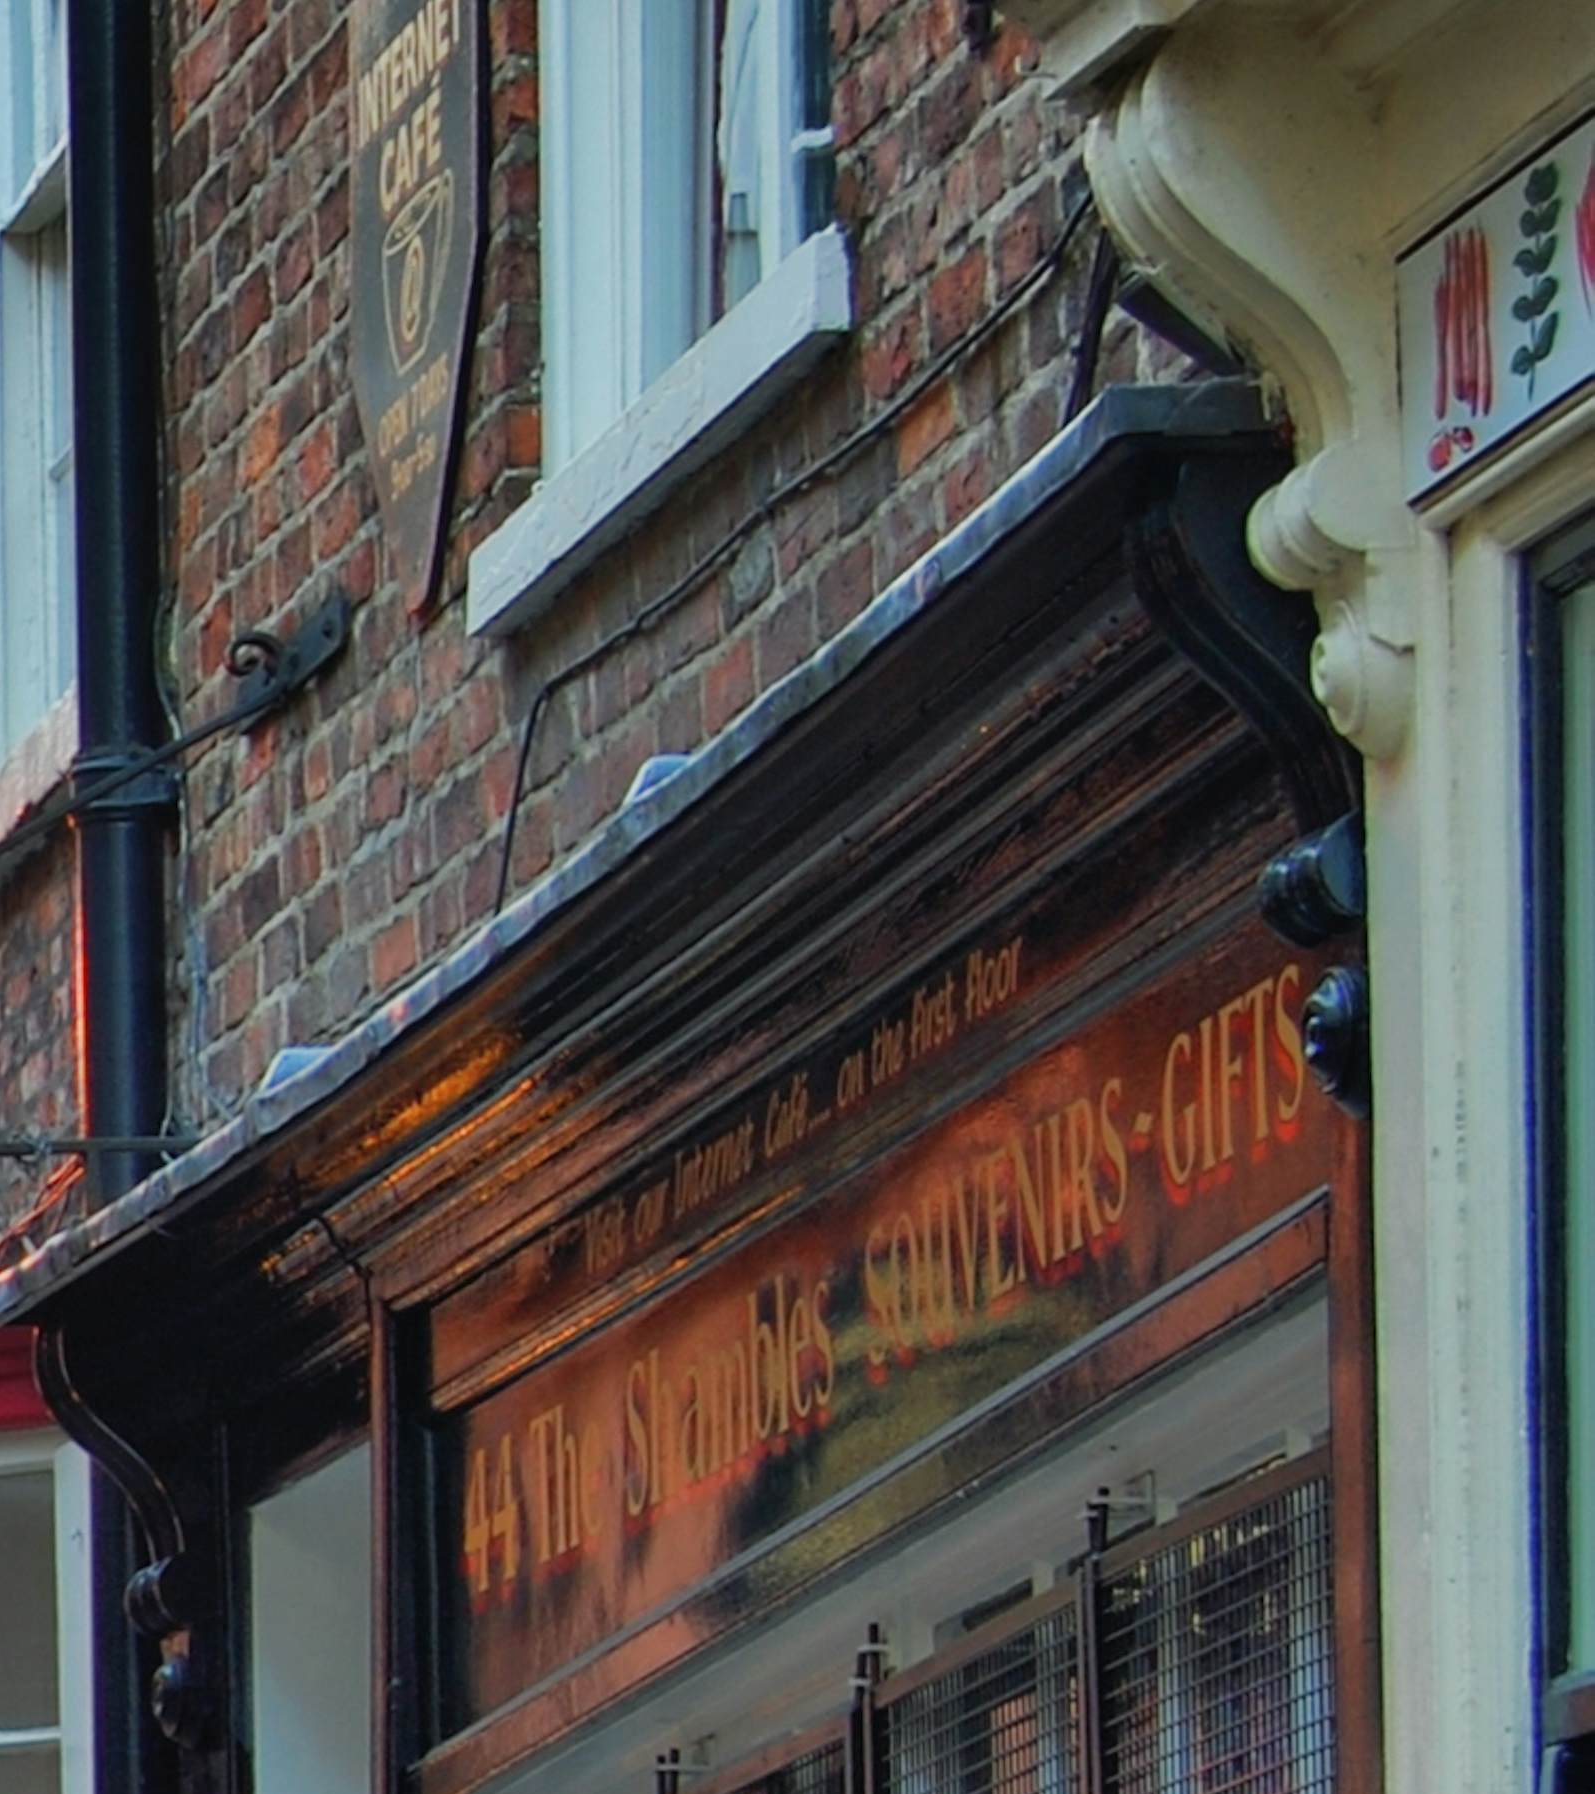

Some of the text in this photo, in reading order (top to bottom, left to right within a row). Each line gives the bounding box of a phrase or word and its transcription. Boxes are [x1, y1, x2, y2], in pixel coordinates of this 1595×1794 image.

[379, 69, 442, 213] CAFÉ
[871, 1018, 905, 1086] the
[463, 1432, 520, 1593] 44
[529, 1405, 604, 1563] The
[625, 1273, 835, 1518] Shambles
[864, 1077, 1128, 1367] SOUVENIRS
[1161, 963, 1305, 1185] GIFTS
